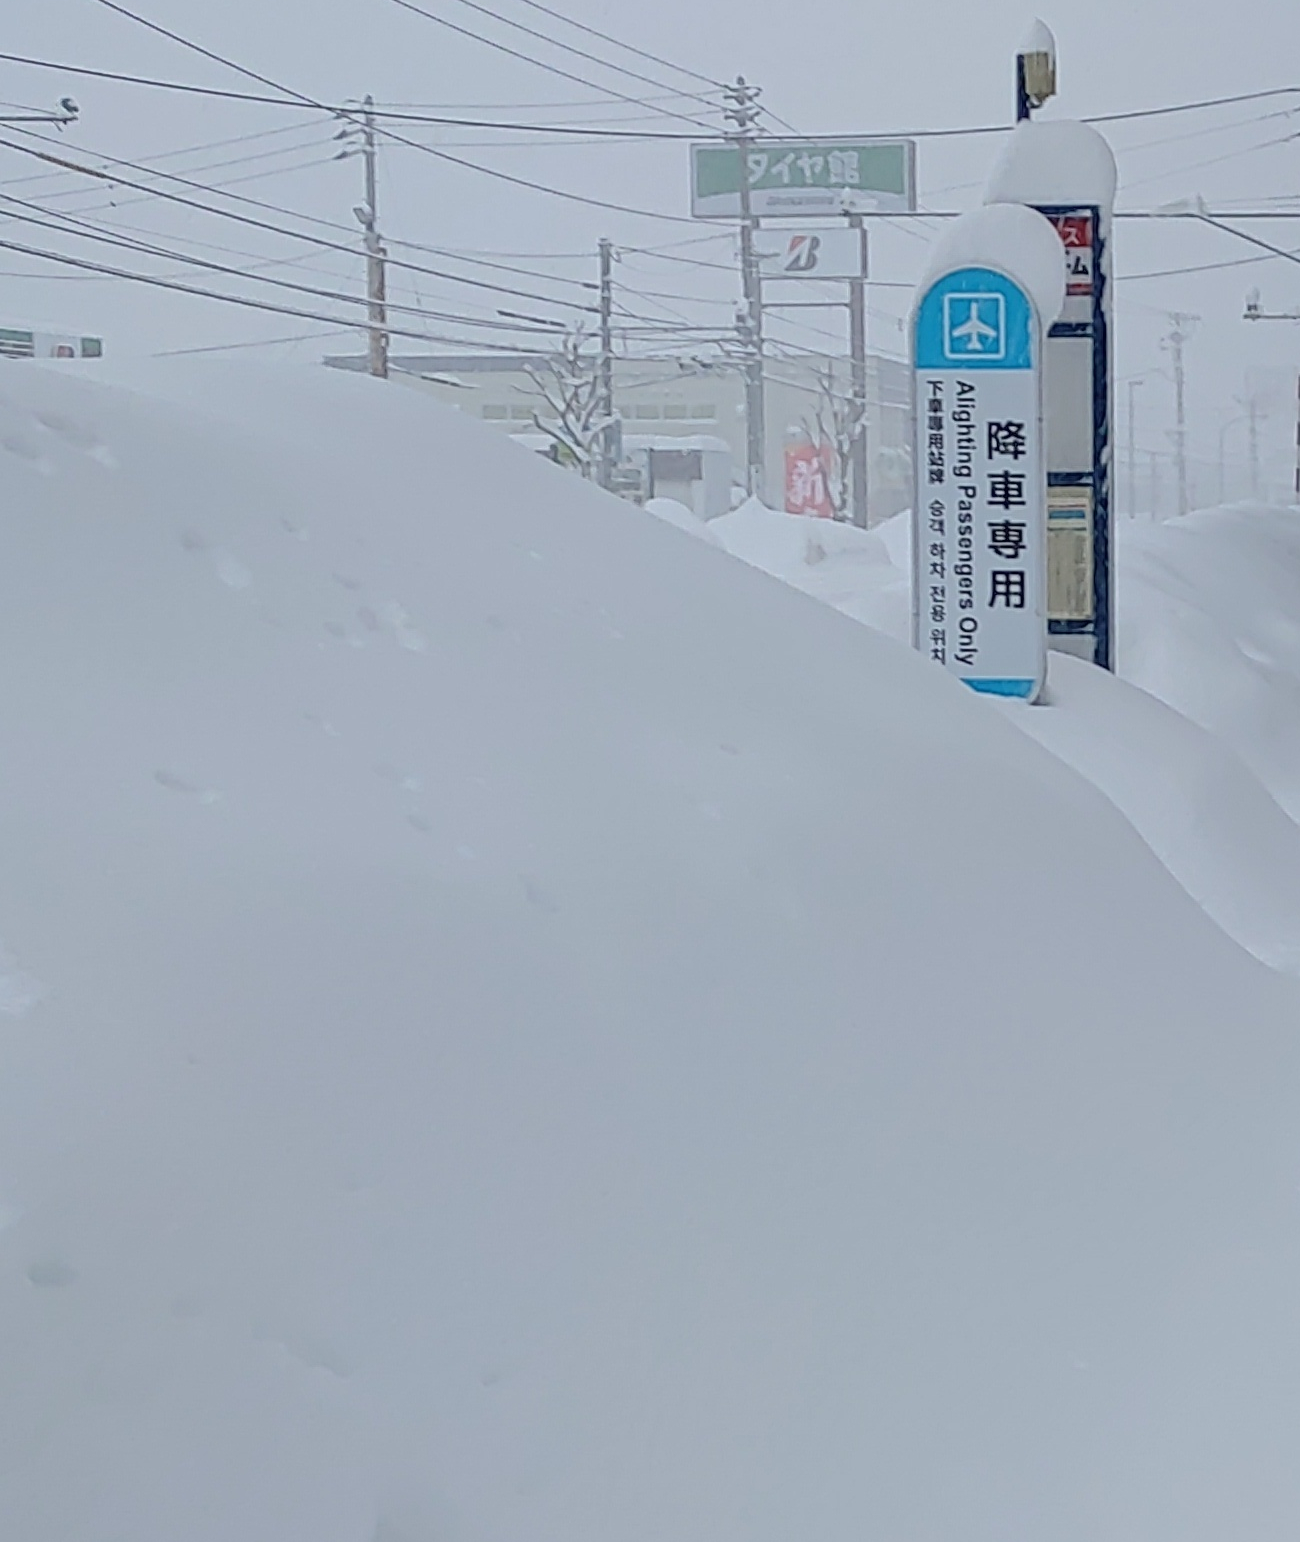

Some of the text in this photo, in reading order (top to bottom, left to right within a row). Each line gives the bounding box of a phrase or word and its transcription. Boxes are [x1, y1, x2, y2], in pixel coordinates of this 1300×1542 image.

[747, 150, 860, 184] タイヤ館
[952, 380, 979, 666] Alighting Passengers Only
[986, 420, 1027, 609] 降車専用
